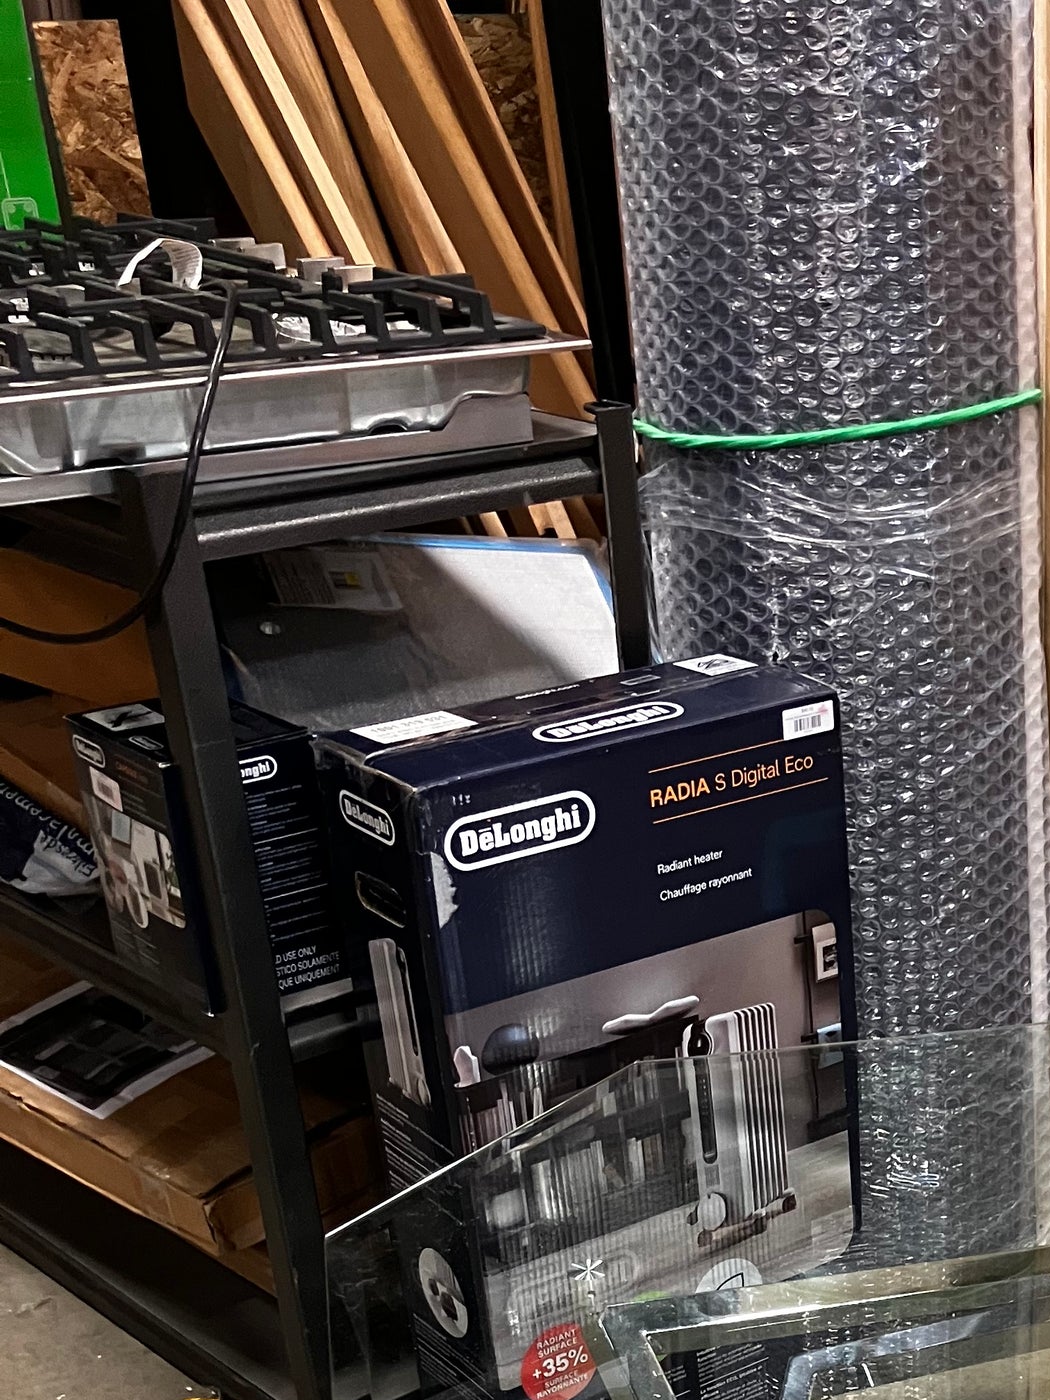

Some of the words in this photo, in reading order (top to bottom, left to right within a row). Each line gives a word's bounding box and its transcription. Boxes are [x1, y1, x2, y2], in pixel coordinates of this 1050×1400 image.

[650, 777, 711, 808] RADIA
[715, 773, 727, 791] S
[731, 759, 779, 788] Digital
[785, 755, 814, 775] Eco
[657, 857, 692, 874] Radiant
[694, 850, 723, 866] heater
[660, 881, 707, 902] Chauffage
[708, 868, 752, 889] rayonnant
[283, 950, 297, 962] USE
[298, 945, 317, 958] ONLY
[297, 951, 340, 973] SOLAMENTE
[294, 964, 340, 985] UNIQUEMENT
[536, 1329, 576, 1350] RADIANT
[537, 1337, 578, 1358] SURFACE
[532, 1346, 588, 1381] +35%
[536, 1373, 588, 1400] RAYONNANTE
[544, 1370, 578, 1389] SURFACE
